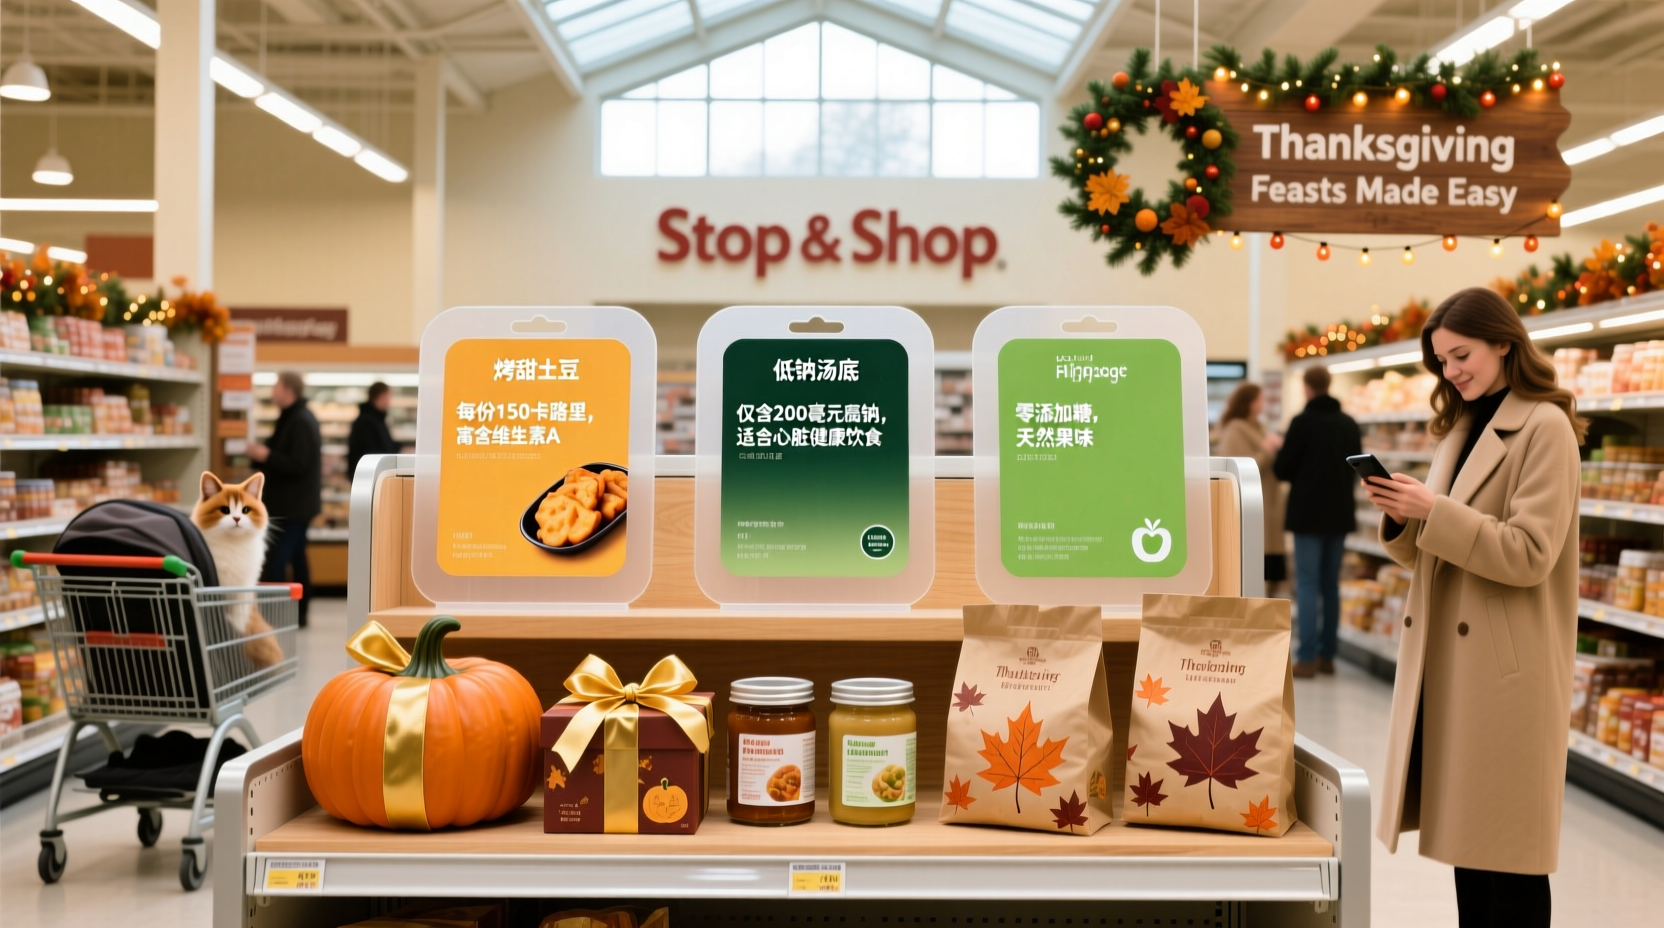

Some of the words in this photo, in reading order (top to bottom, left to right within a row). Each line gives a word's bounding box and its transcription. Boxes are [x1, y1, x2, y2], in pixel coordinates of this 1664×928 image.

[1252, 122, 1515, 173] Thanksgiving
[1251, 174, 1347, 204] Feasts
[1356, 175, 1440, 205] Made
[1448, 176, 1518, 215] Easy
[658, 207, 791, 279] Stop
[800, 214, 842, 263] &
[852, 208, 998, 279] Shop
[493, 357, 580, 382] 烤甜土豆
[772, 357, 860, 382] 低钠汤底
[1016, 427, 1094, 449] 天然果味
